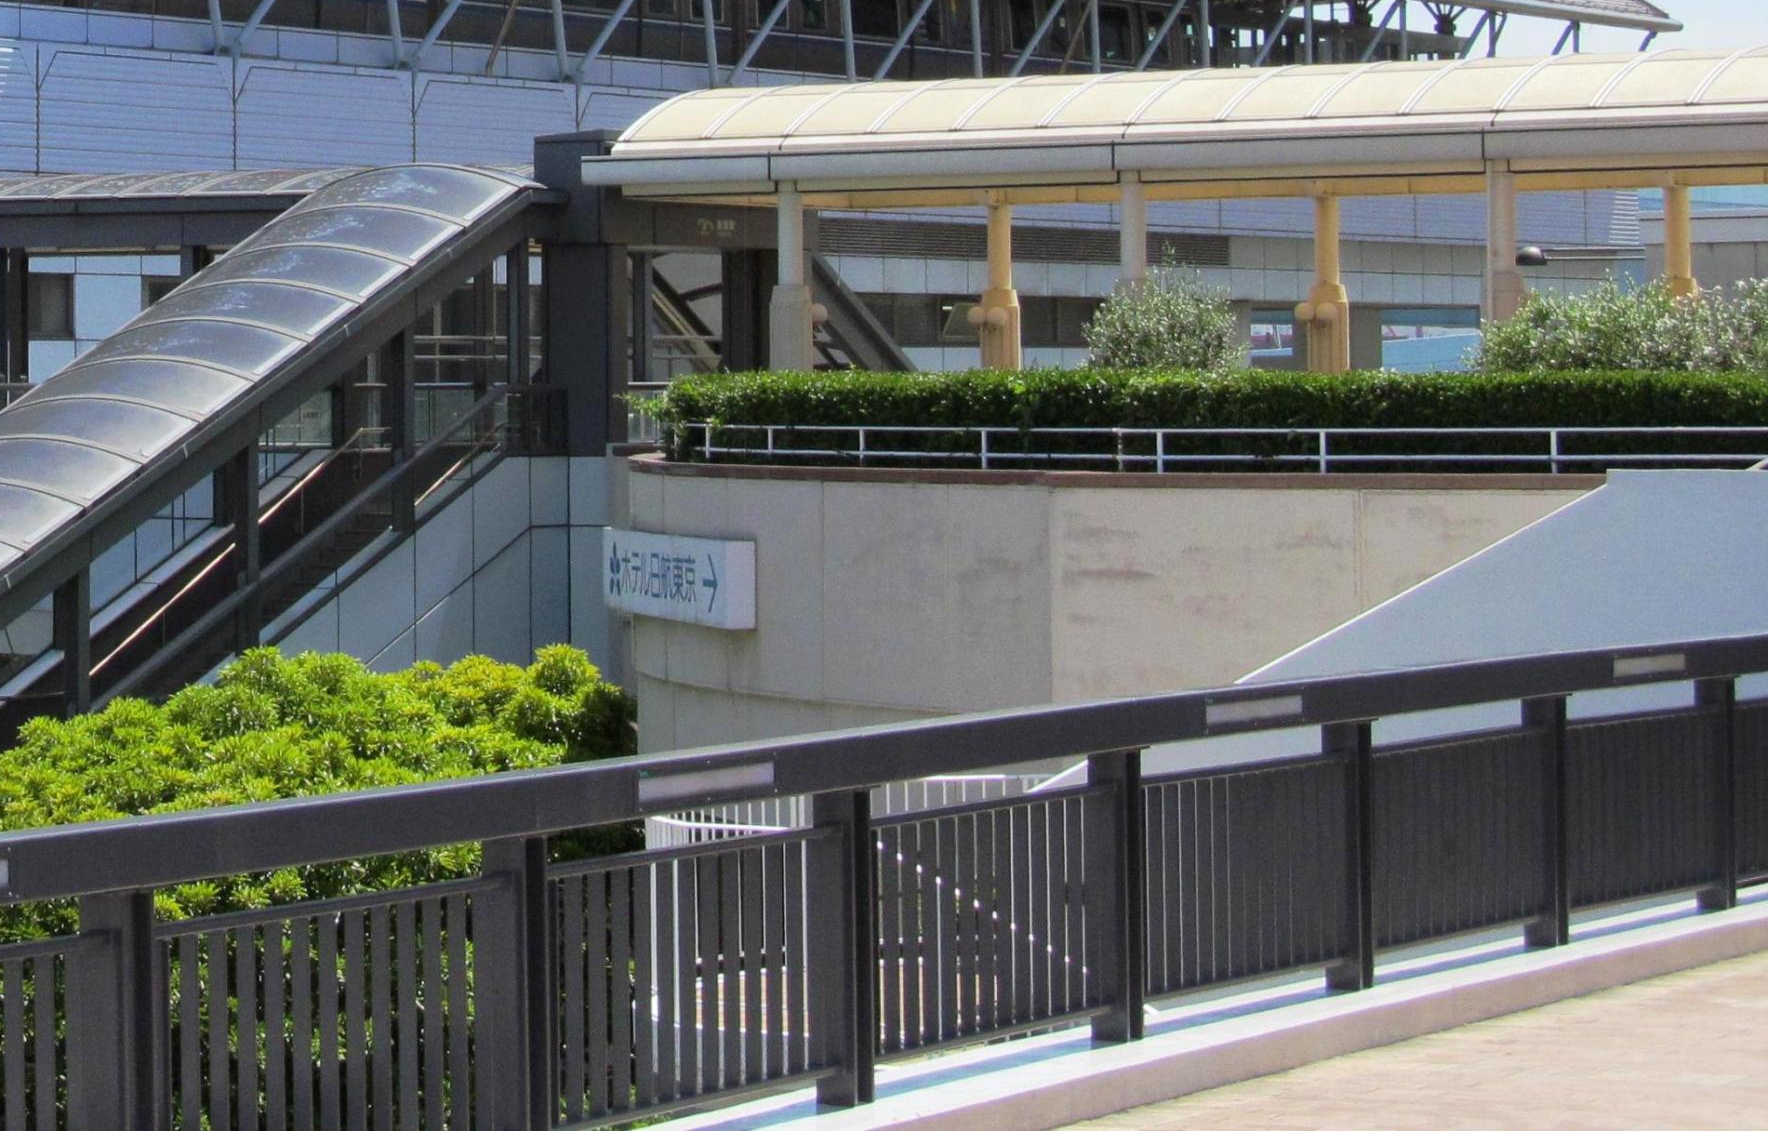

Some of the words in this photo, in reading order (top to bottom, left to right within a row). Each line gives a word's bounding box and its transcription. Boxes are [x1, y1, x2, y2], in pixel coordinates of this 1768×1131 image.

[621, 550, 697, 604] ホテル日航東京
